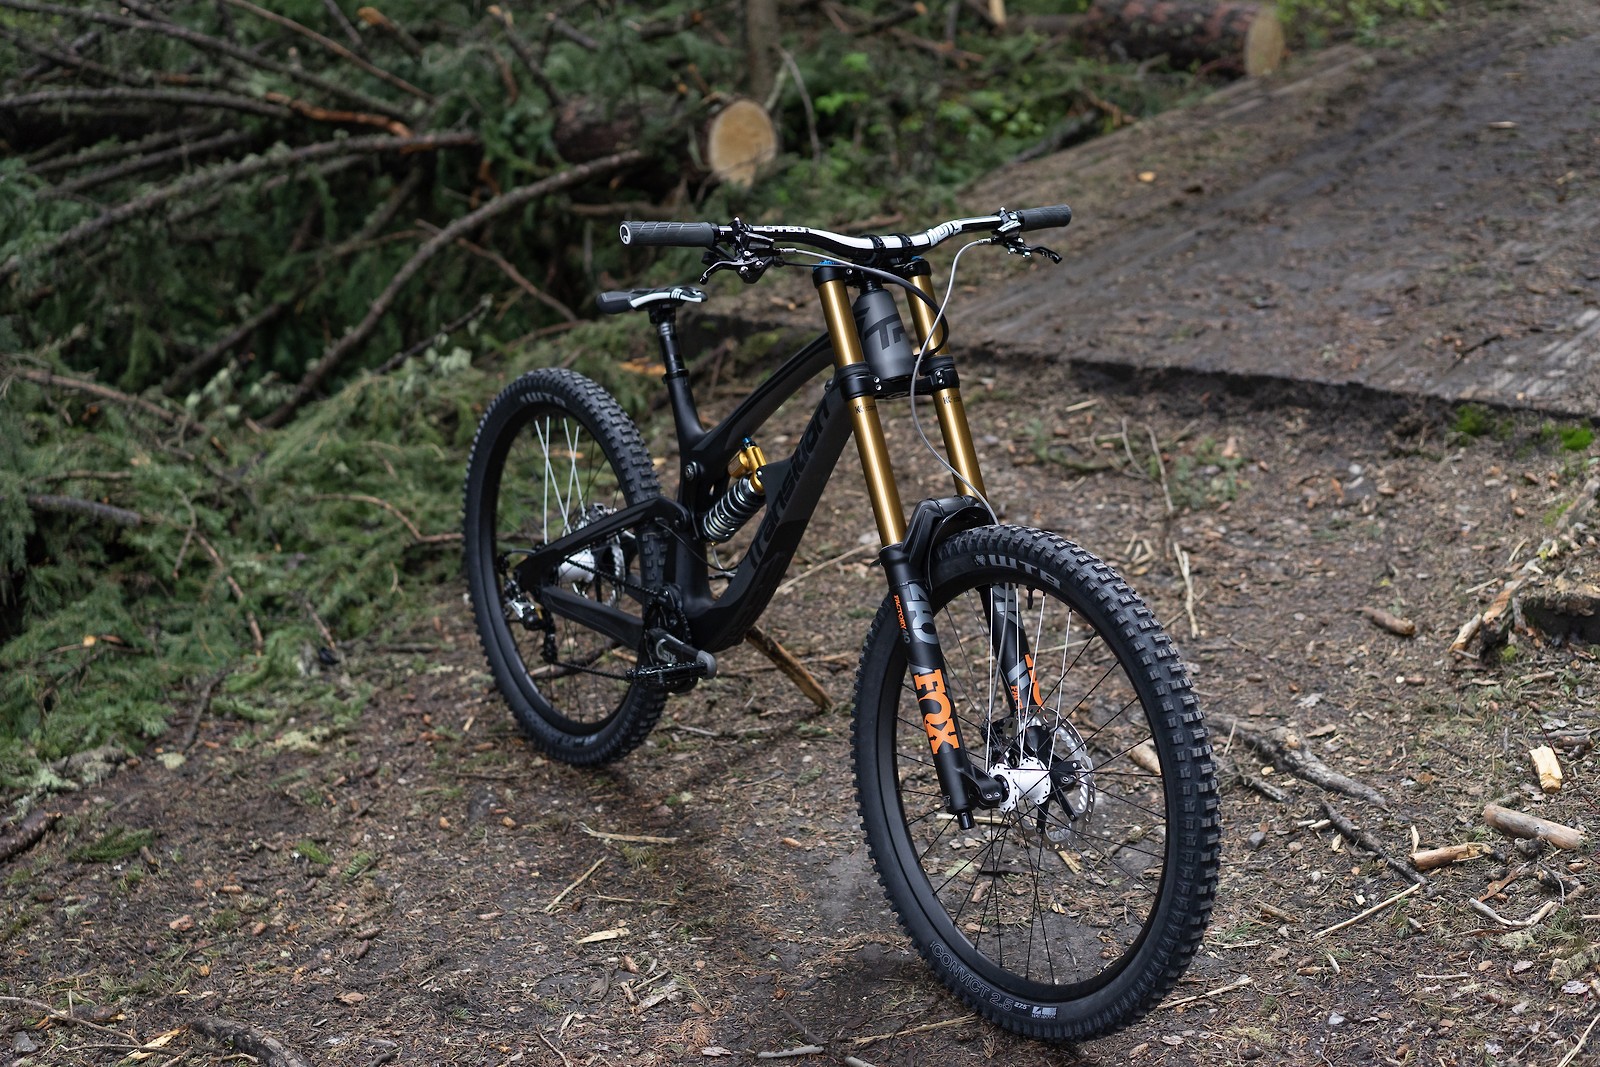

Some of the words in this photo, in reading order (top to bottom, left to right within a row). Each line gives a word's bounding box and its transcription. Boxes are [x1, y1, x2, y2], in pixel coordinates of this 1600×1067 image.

[988, 554, 1060, 589] WTB
[893, 594, 907, 629] FACTORY
[914, 668, 960, 755] FOX
[932, 943, 990, 997] CONVICT
[989, 992, 1014, 1011] 2.5
